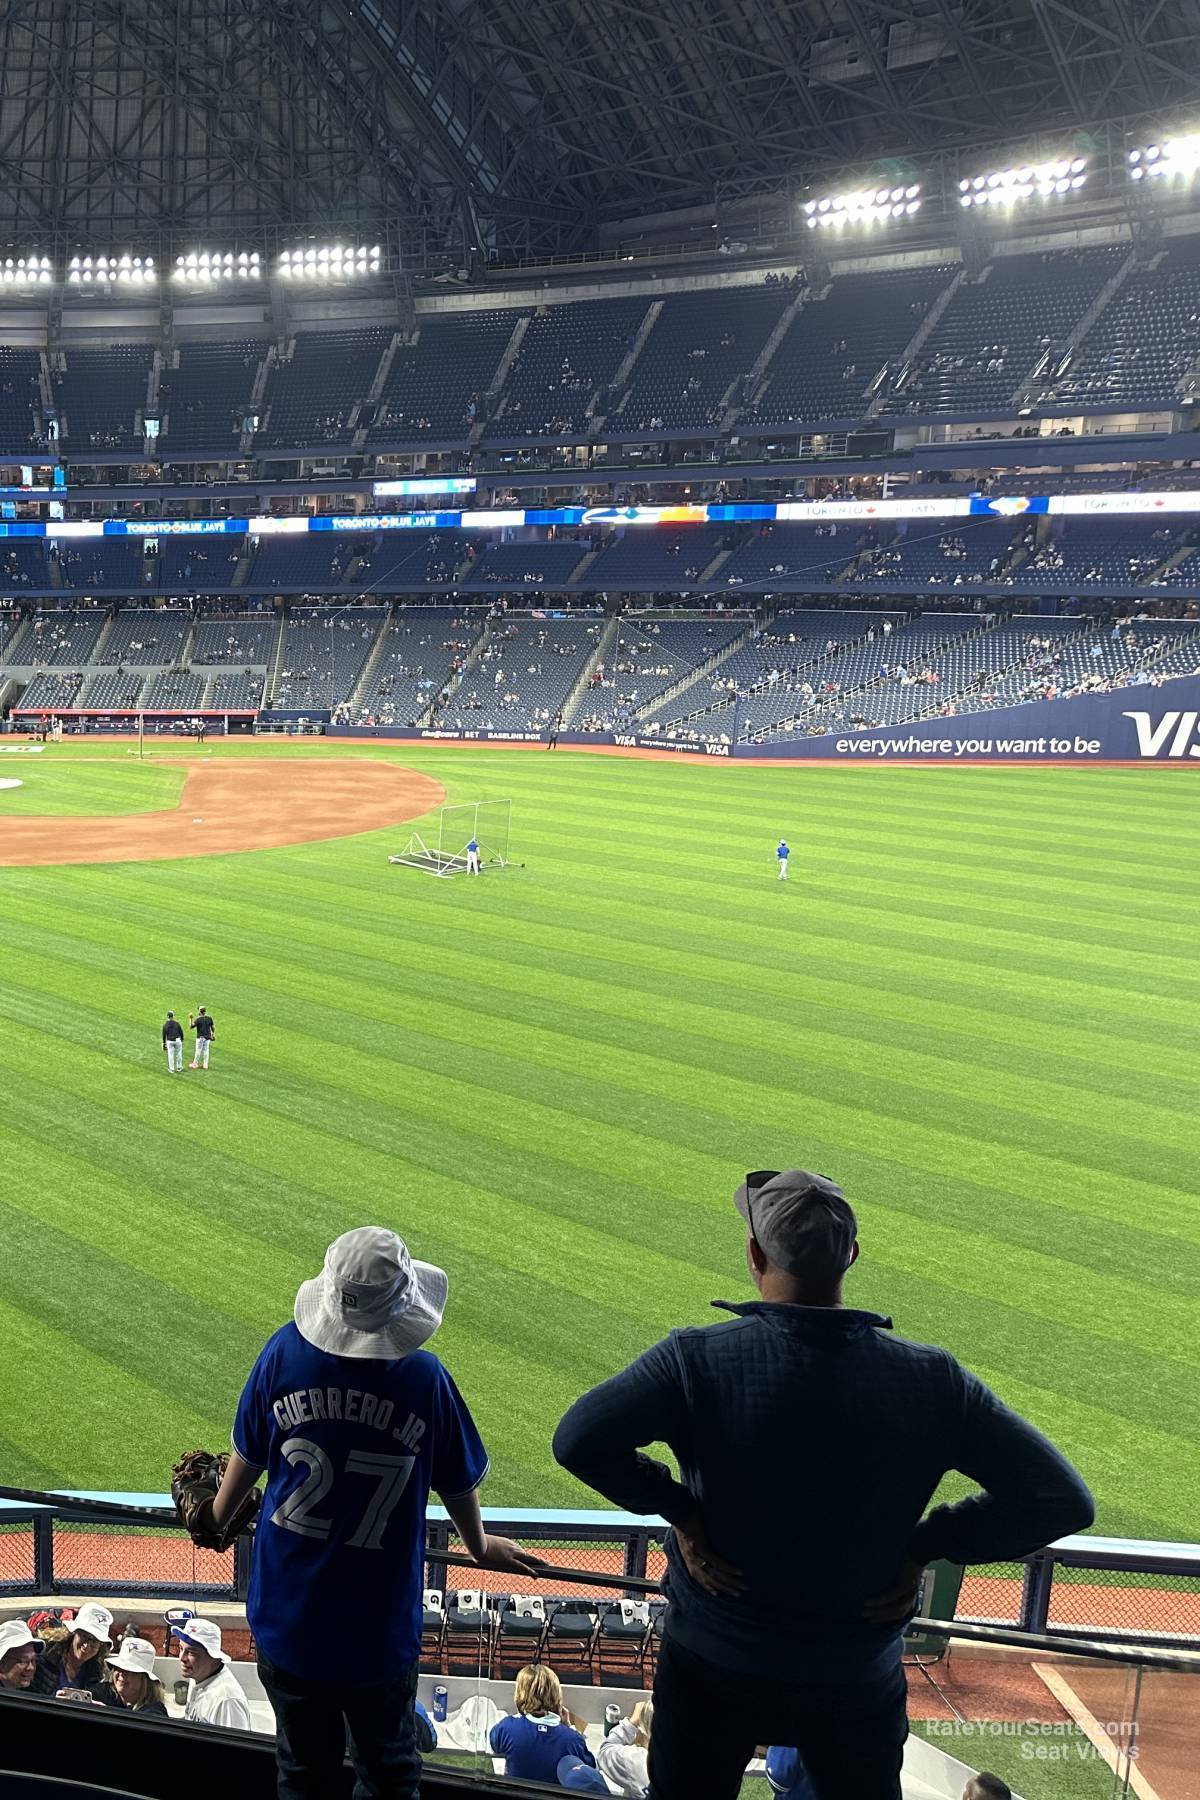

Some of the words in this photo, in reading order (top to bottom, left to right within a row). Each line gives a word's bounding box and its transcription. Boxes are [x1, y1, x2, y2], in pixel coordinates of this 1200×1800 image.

[126, 521, 170, 533] TORONTO
[181, 521, 202, 532] BLUE
[204, 521, 225, 532] JAYS
[332, 517, 379, 528] TORONTO
[390, 516, 412, 527] BLUE
[414, 515, 437, 526] JAYS
[487, 732, 524, 740] BASELINE
[613, 734, 637, 746] VISA
[704, 743, 729, 756] VISA
[836, 735, 953, 756] everywhere
[954, 739, 992, 756] you
[996, 737, 1046, 753] want
[1049, 737, 1072, 753] to
[1074, 736, 1101, 753] be
[272, 1387, 395, 1432] GUERRERO
[392, 1412, 427, 1454] JR.
[270, 1437, 417, 1550] 27
